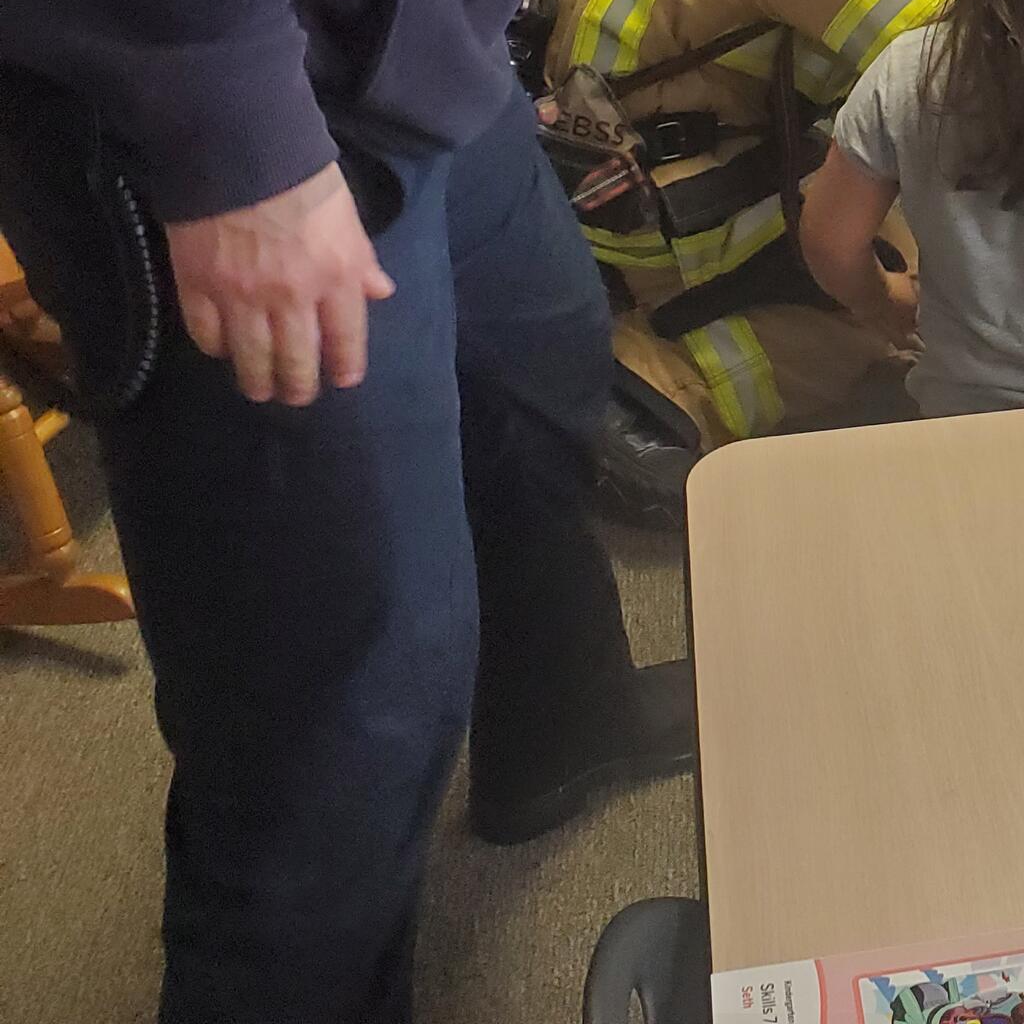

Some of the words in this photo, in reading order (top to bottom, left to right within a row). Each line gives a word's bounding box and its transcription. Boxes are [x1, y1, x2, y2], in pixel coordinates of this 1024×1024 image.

[741, 985, 754, 1009] Seth
[760, 982, 777, 1015] Skills
[784, 980, 795, 1024] Kindergarte
[763, 1016, 778, 1024] 7
